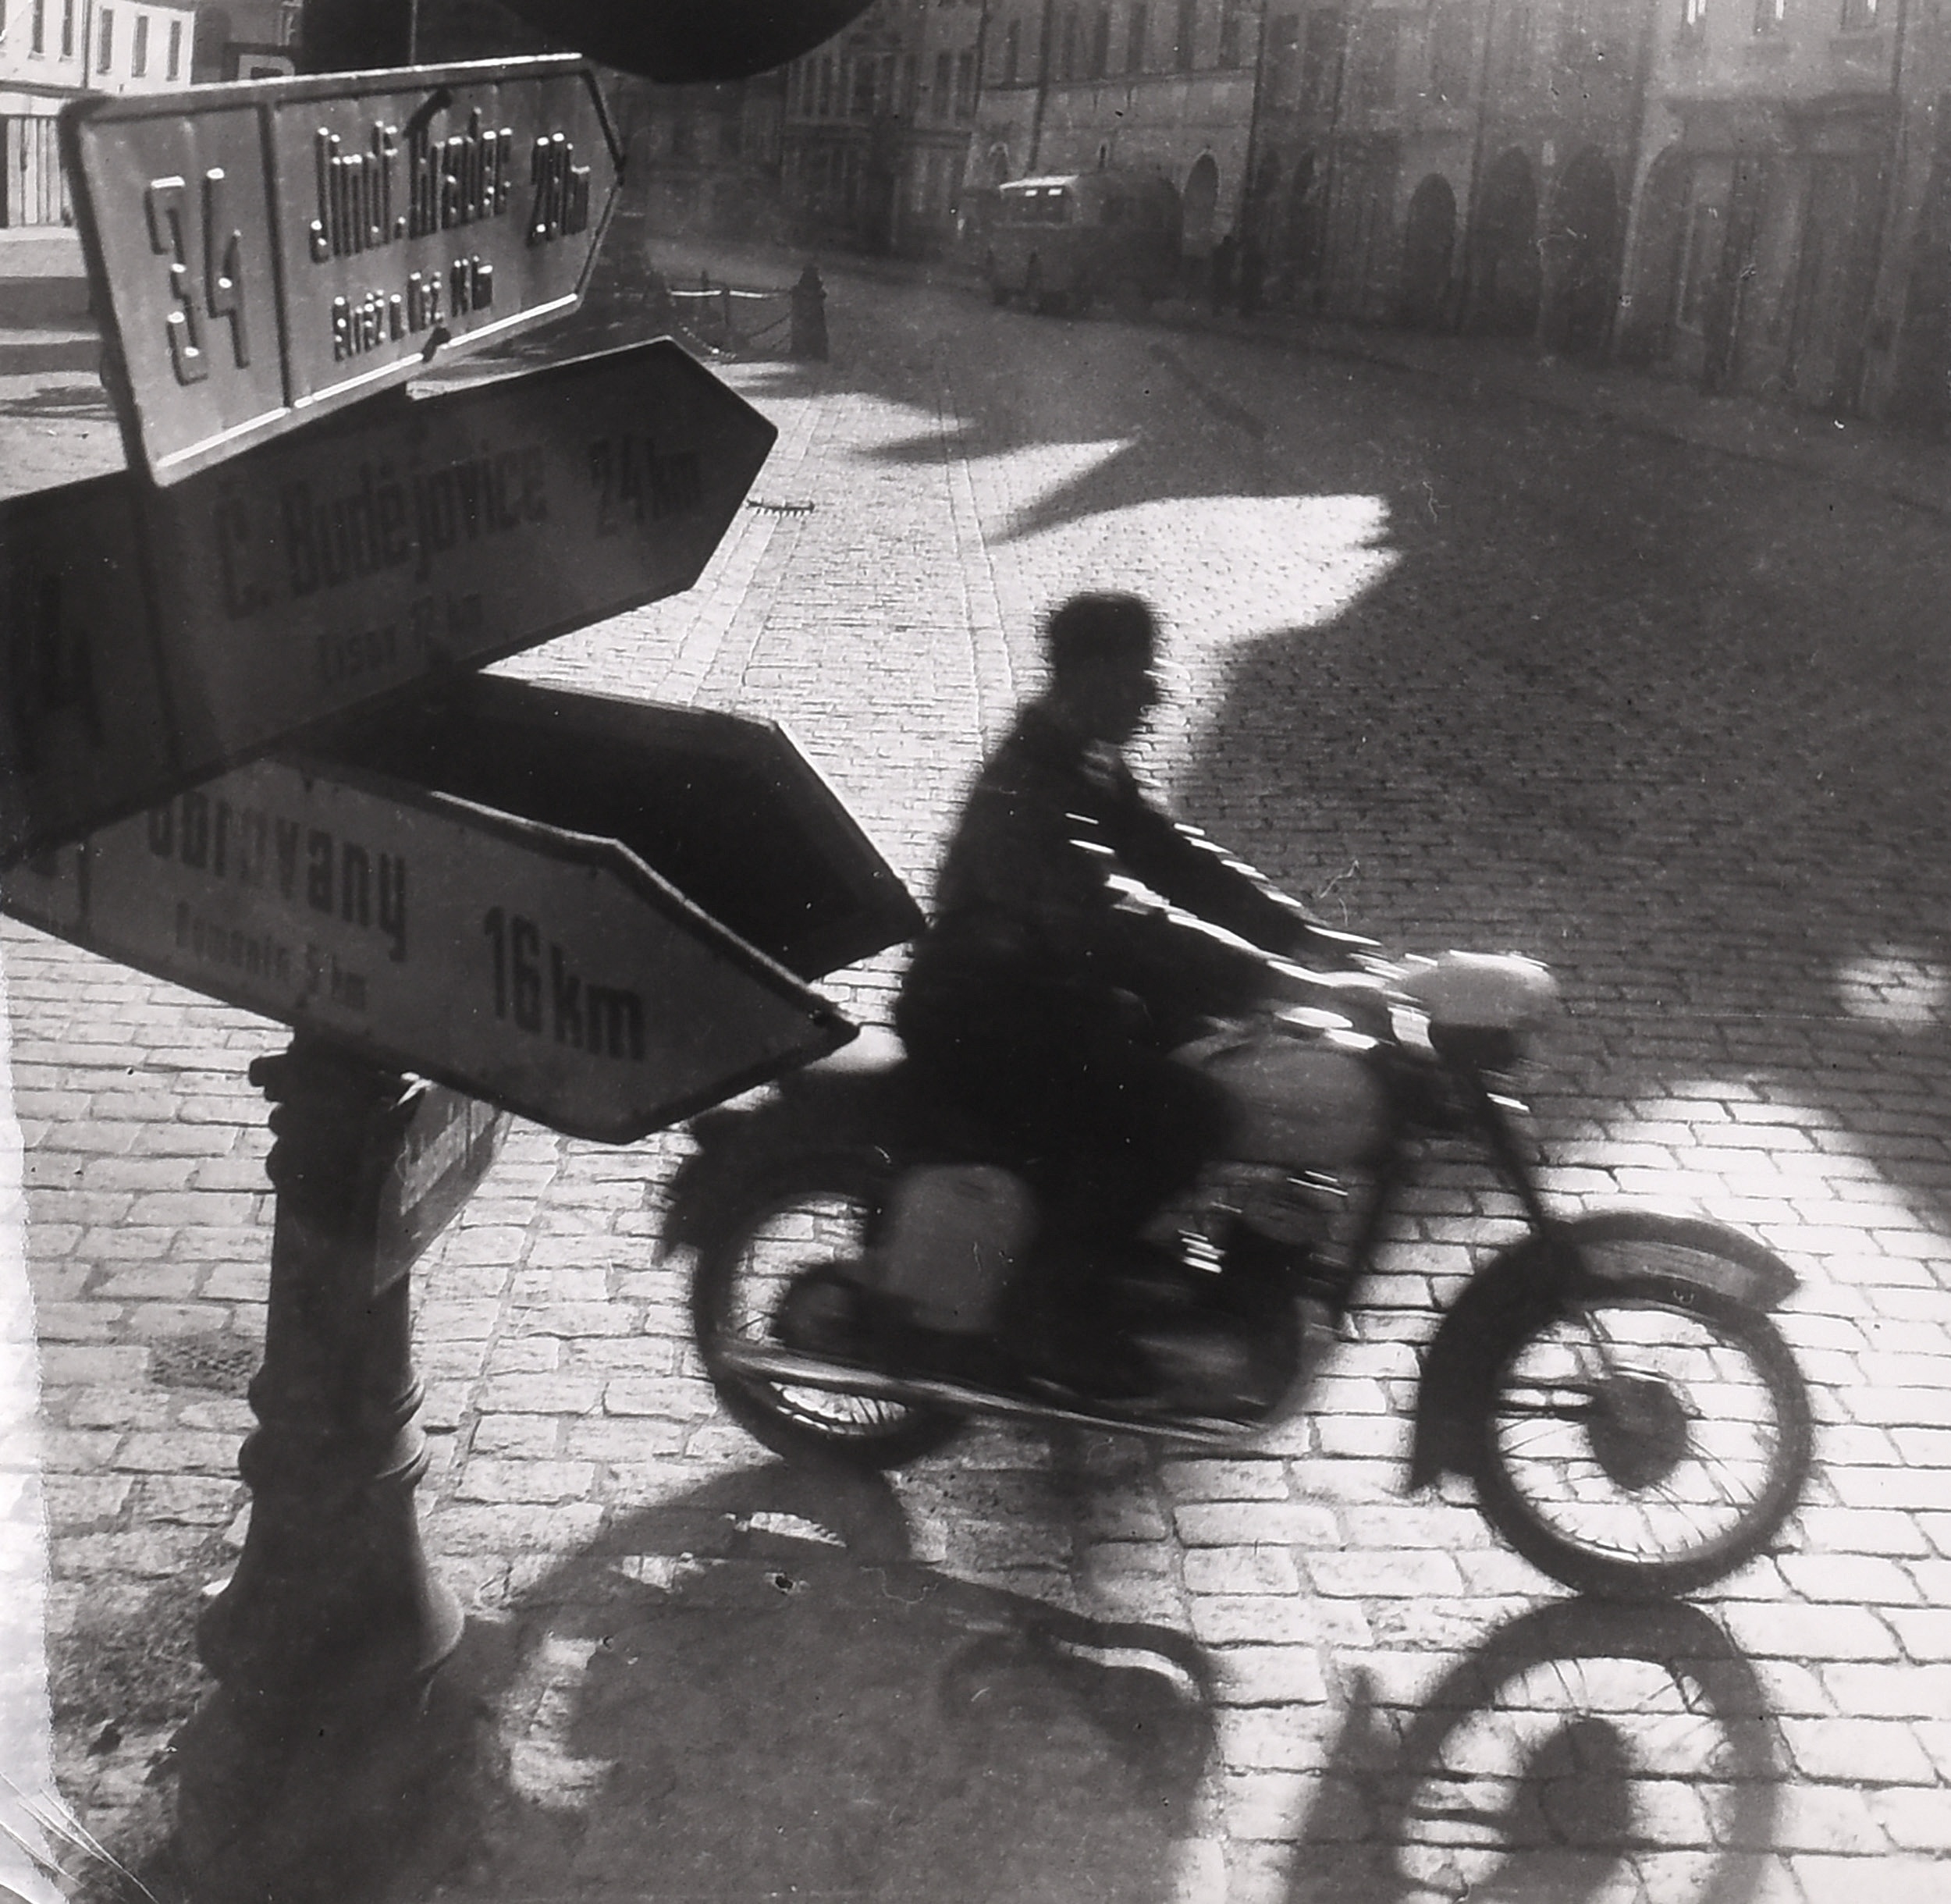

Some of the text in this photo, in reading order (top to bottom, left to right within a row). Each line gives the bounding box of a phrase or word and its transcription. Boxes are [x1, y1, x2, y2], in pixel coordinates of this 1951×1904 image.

[408, 106, 514, 240] Hradec
[144, 167, 251, 386] 34
[279, 439, 550, 598] Budějovice
